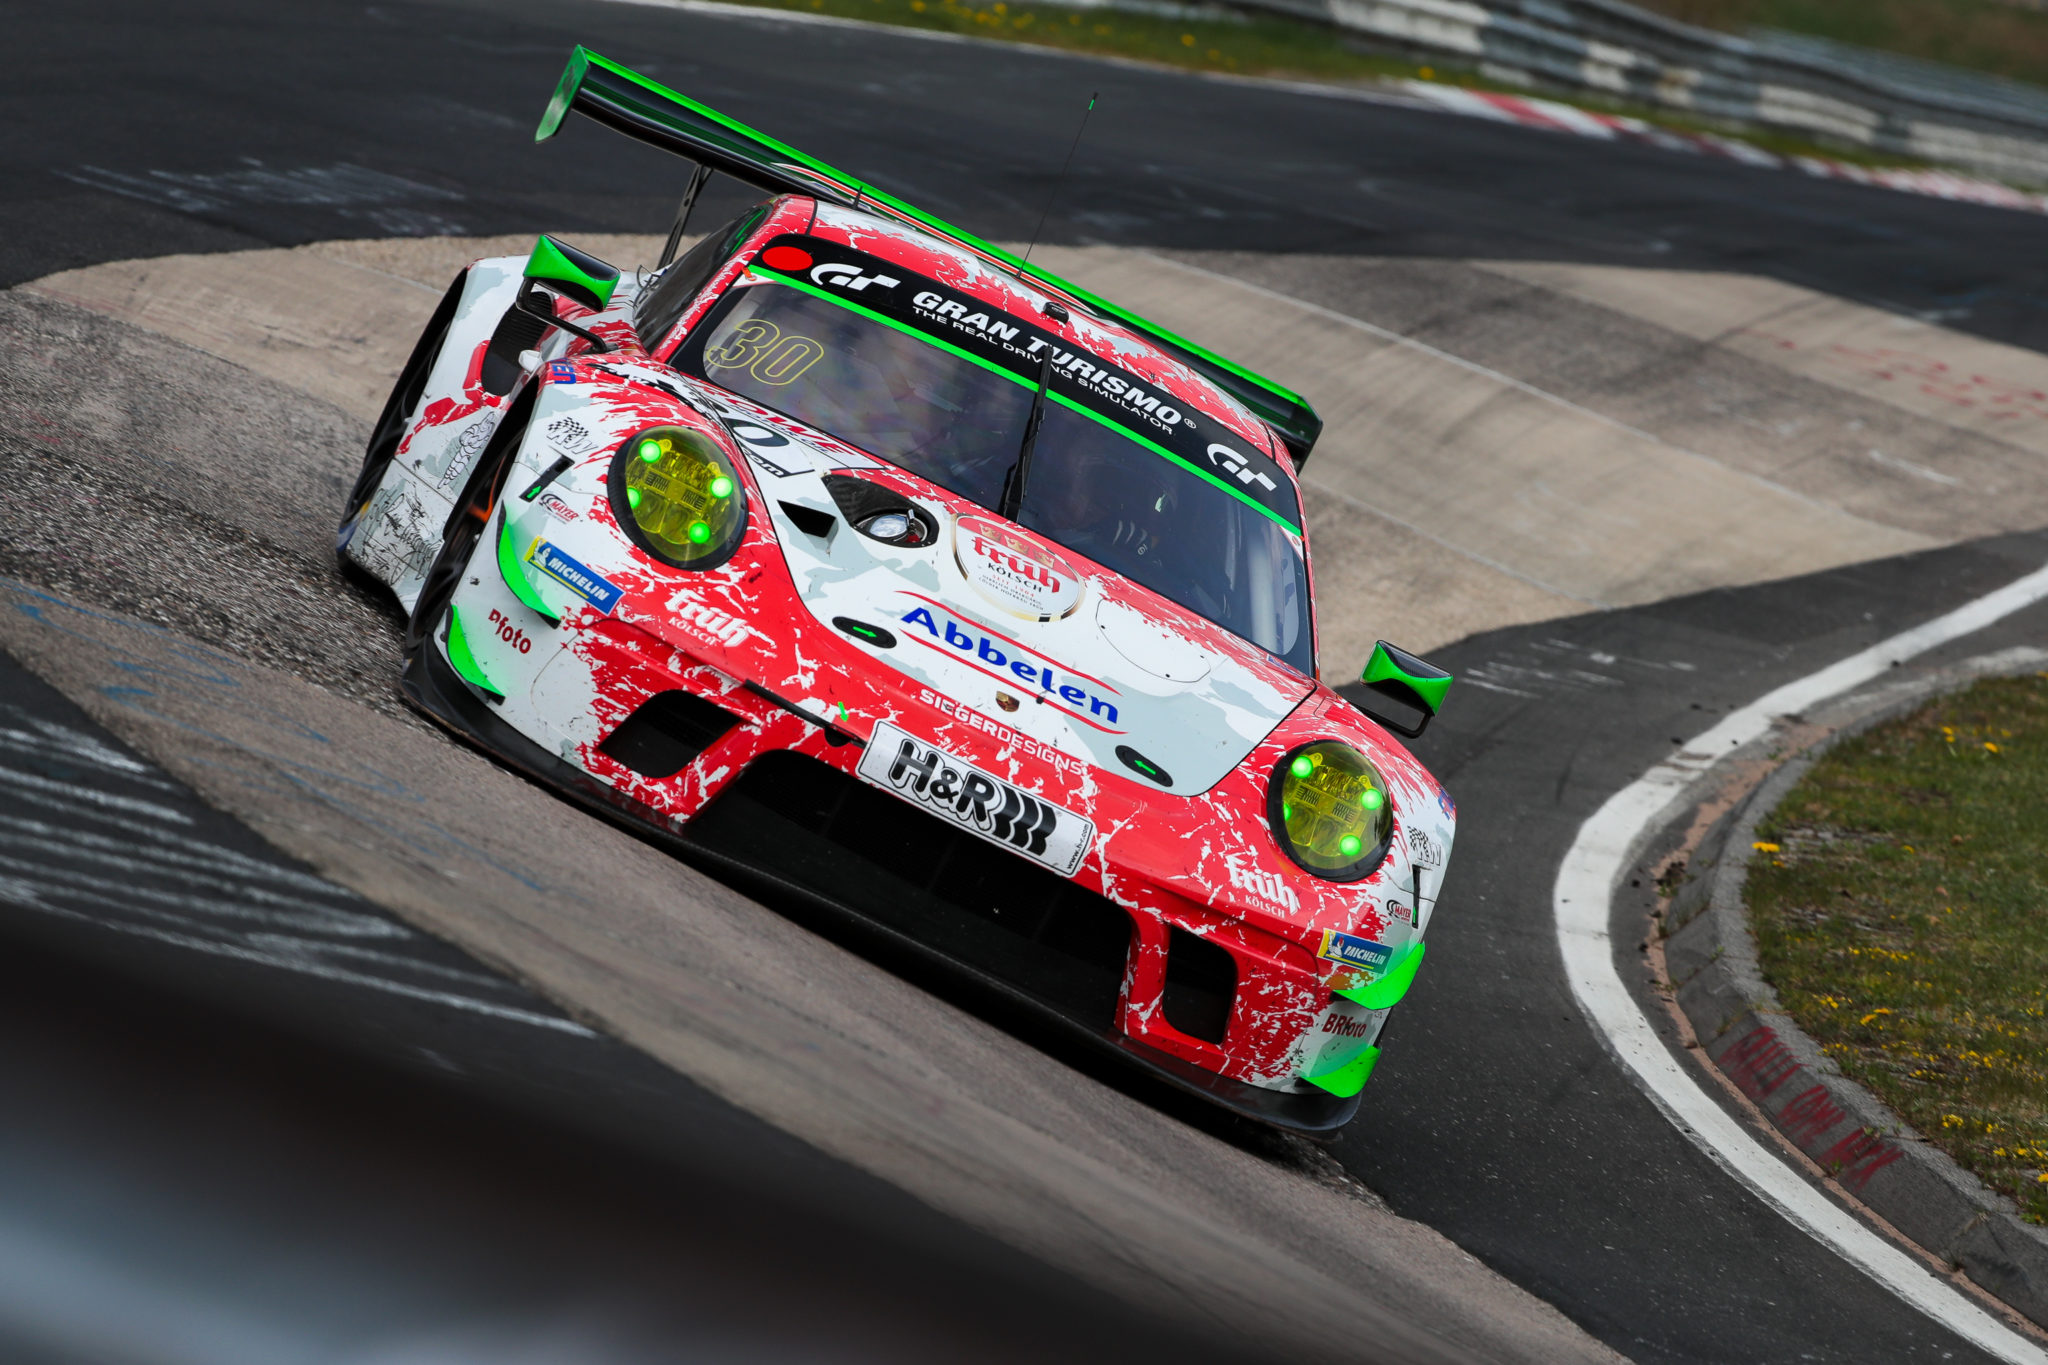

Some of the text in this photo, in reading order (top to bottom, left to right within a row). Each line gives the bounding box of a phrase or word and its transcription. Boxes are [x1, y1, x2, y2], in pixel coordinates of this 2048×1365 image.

[706, 318, 825, 386] 30
[912, 291, 1182, 425] GRAN TURISMO
[913, 306, 1174, 436] THE REAL DRIVNG SIMULATOR
[549, 500, 579, 520] MAYER
[548, 557, 611, 601] MICHELIN
[988, 562, 1042, 594] KÖLSCH
[668, 617, 718, 646] KÖLSCH
[901, 607, 1119, 725] Abbelen
[889, 739, 996, 823] H&R
[1066, 823, 1090, 870] www.h-r.com
[1245, 894, 1285, 919] KÖLSCH
[1394, 904, 1411, 919] MAYER
[1343, 945, 1387, 965] MICHELIN
[1322, 1013, 1368, 1038] BRfoto
